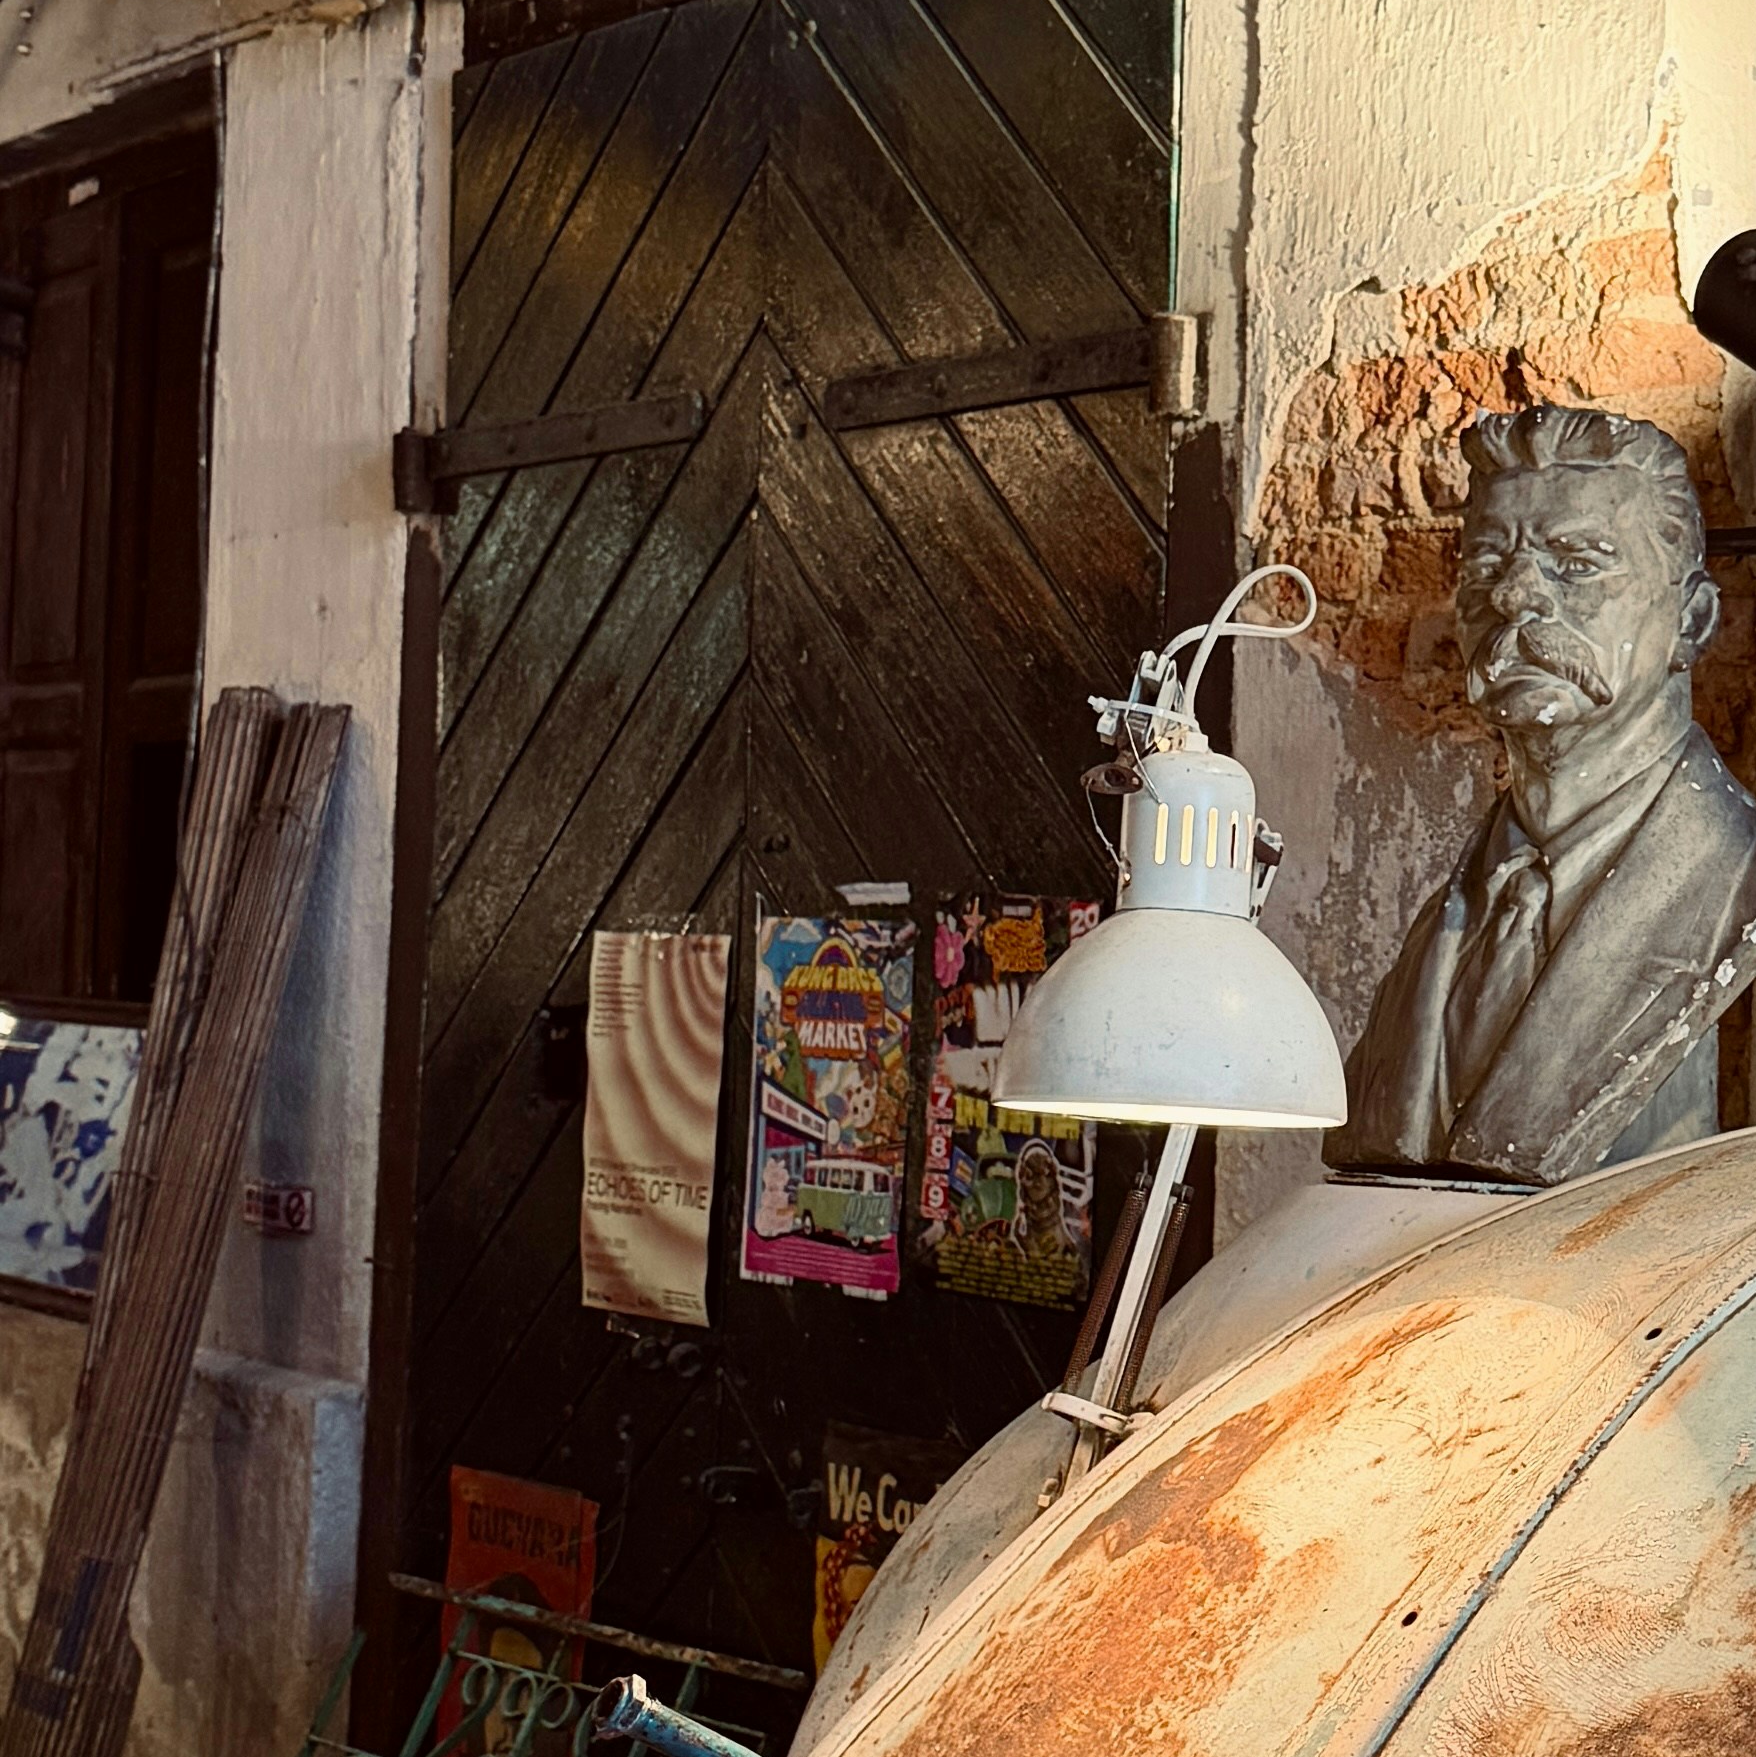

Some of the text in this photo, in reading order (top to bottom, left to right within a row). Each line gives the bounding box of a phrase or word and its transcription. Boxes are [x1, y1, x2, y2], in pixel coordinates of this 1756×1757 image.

[1070, 903, 1099, 936] 20
[799, 1022, 867, 1052] MARKET
[934, 1086, 952, 1108] 7
[930, 1136, 947, 1158] 8
[587, 1171, 647, 1204] ECHOES
[649, 1179, 672, 1204] OF
[674, 1182, 709, 1212] TIME
[928, 1185, 944, 1207] 9
[827, 1462, 872, 1524] We
[467, 1502, 580, 1571] GUEVARA
